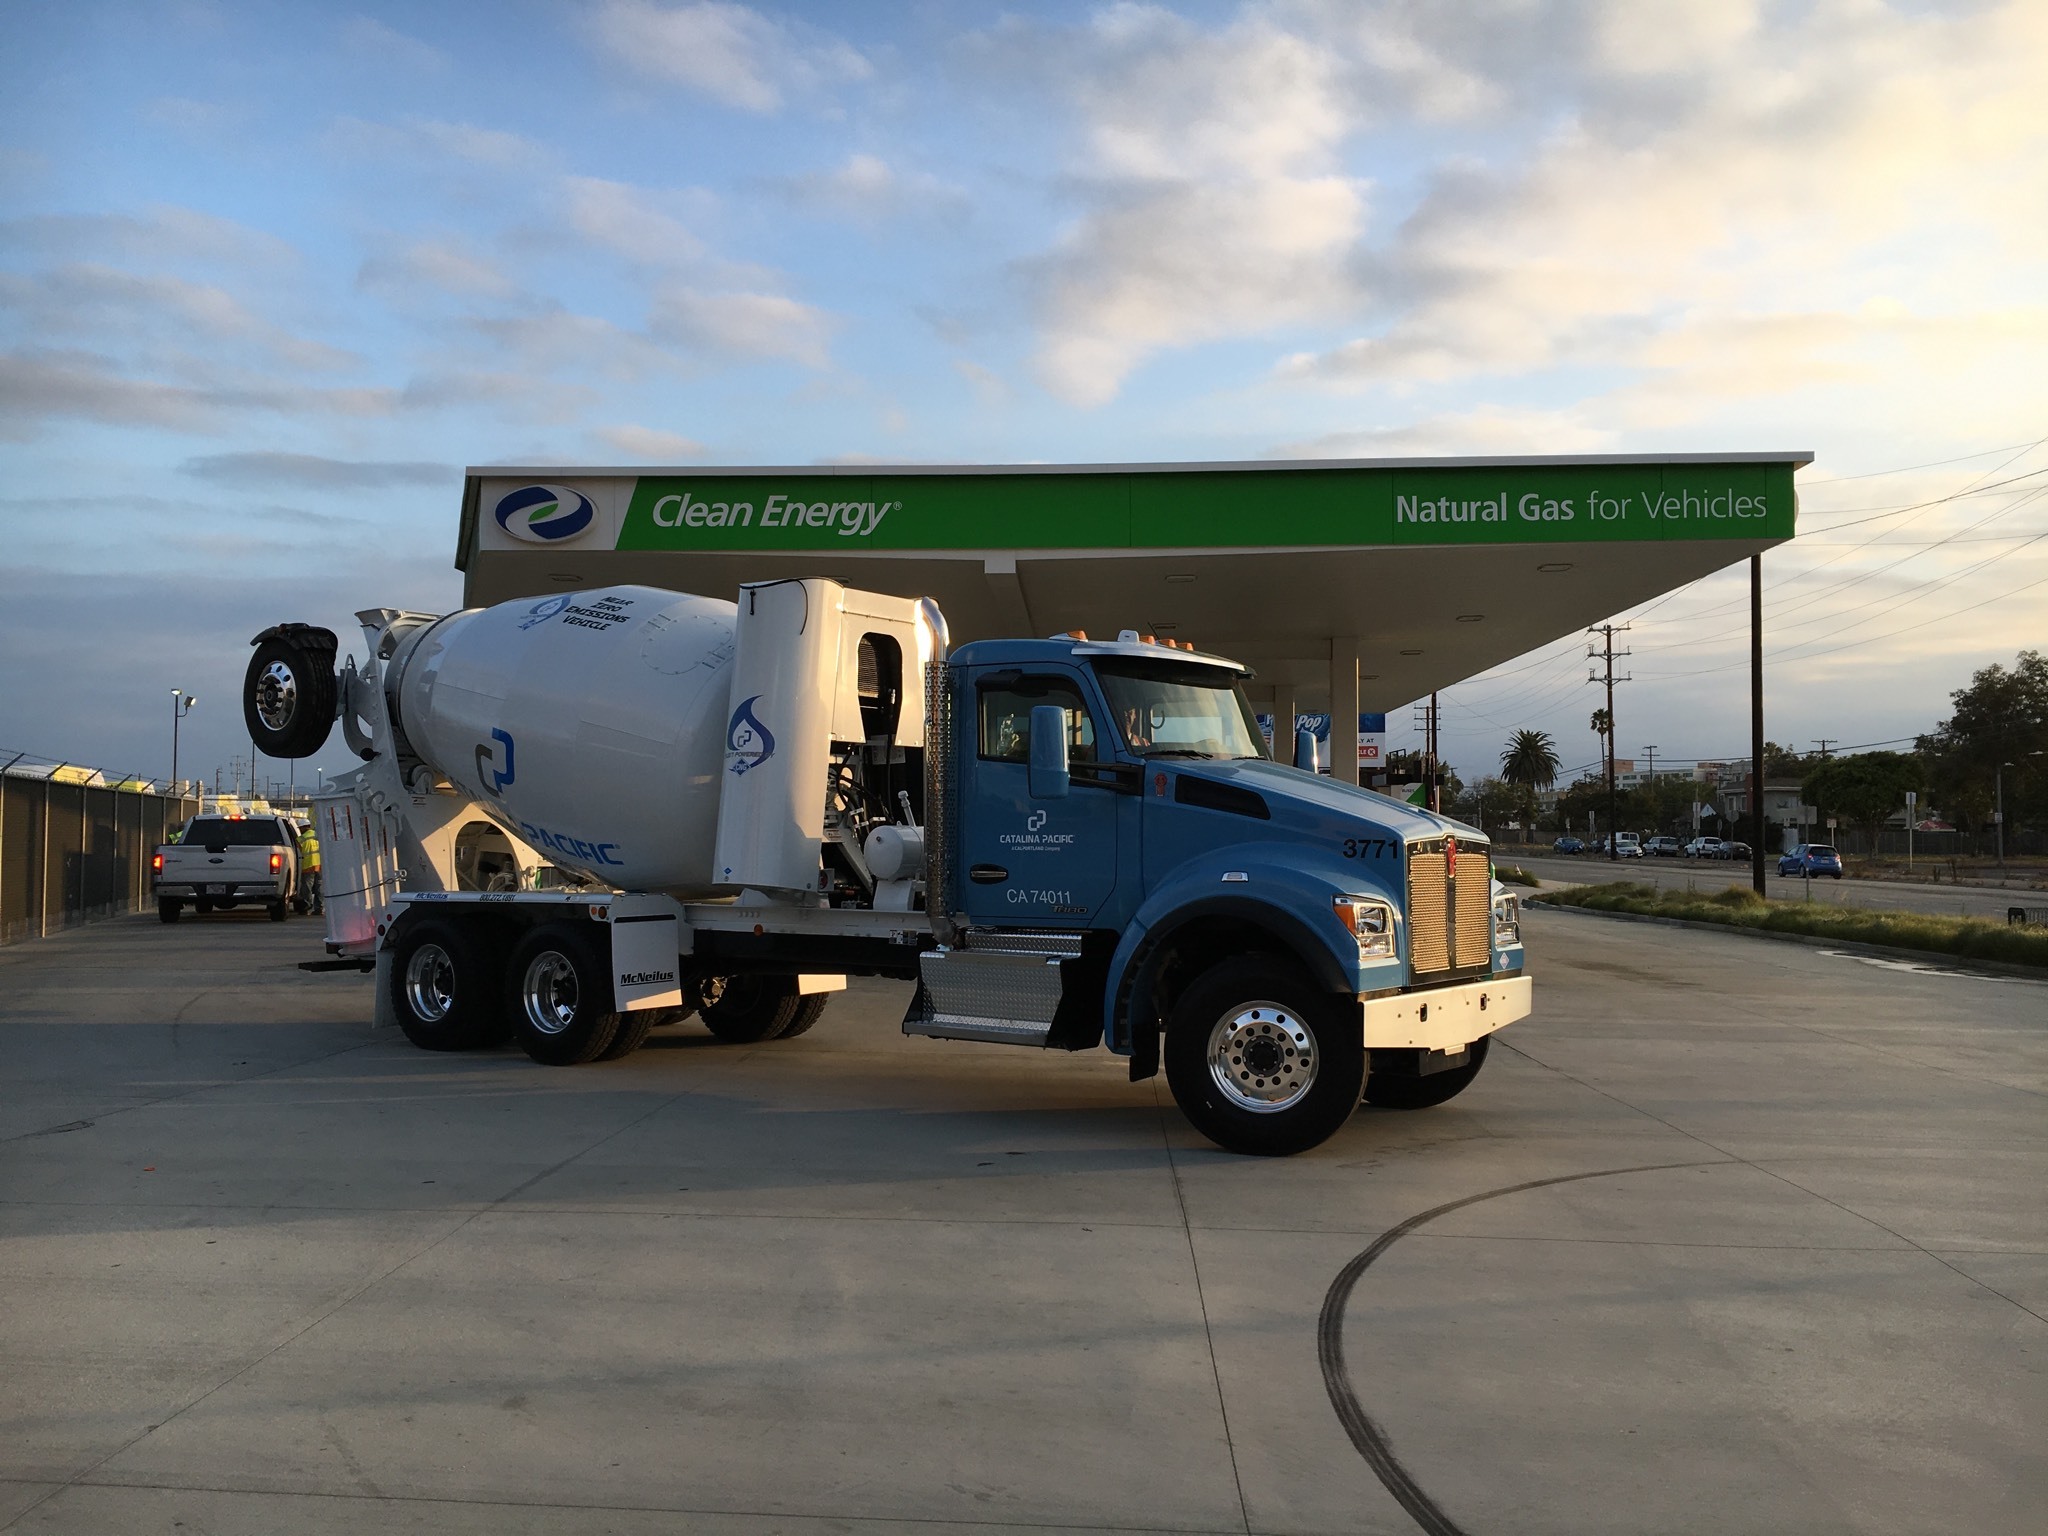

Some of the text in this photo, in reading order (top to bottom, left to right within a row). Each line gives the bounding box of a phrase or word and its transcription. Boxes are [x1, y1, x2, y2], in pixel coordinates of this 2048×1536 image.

[652, 493, 753, 527] Clean
[1396, 488, 1768, 523] Natural Gas for Vehicles
[590, 602, 622, 612] ZERO
[600, 596, 634, 606] NEAR
[564, 605, 631, 623] EMISSIONS
[562, 615, 612, 631] VEHICLE
[1297, 714, 1322, 731] Pop
[735, 763, 748, 771] CNG
[521, 822, 624, 865] PACIFIC
[1000, 835, 1073, 843] CATALINA PACIFIC
[1343, 839, 1398, 859] 3771
[1007, 889, 1071, 904] CA 74011
[621, 971, 674, 985] McNeilus
